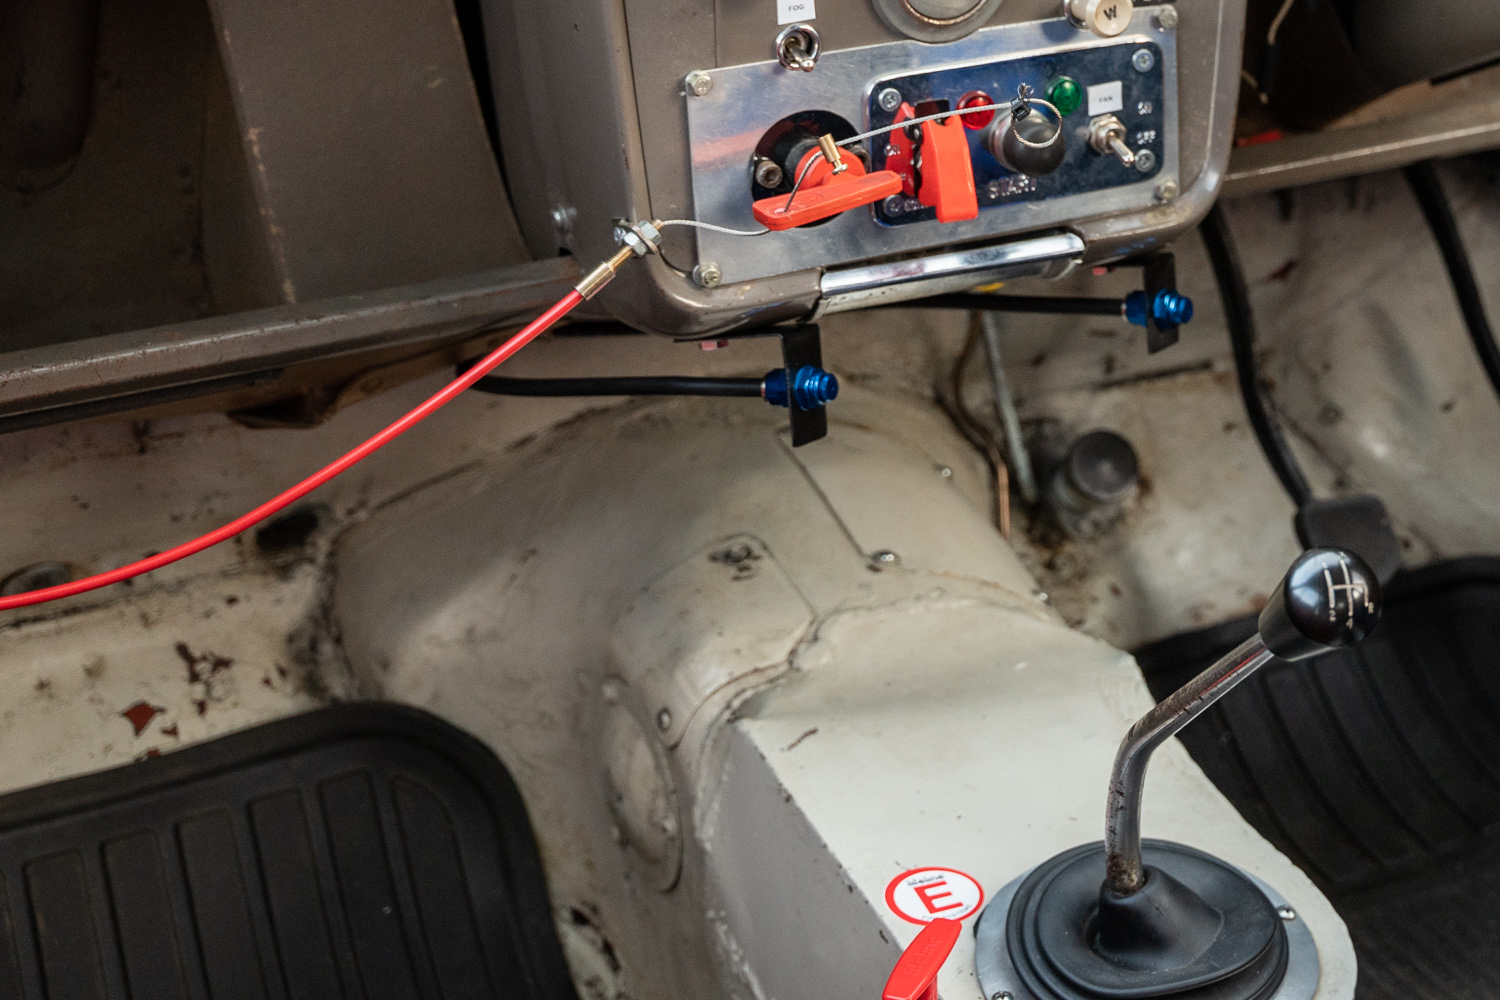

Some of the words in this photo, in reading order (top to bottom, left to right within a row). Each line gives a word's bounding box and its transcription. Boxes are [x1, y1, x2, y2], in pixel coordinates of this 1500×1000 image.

[788, 3, 805, 12] FOG
[1103, 4, 1117, 21] W
[1329, 610, 1336, 622] 2
[914, 880, 963, 914] E
